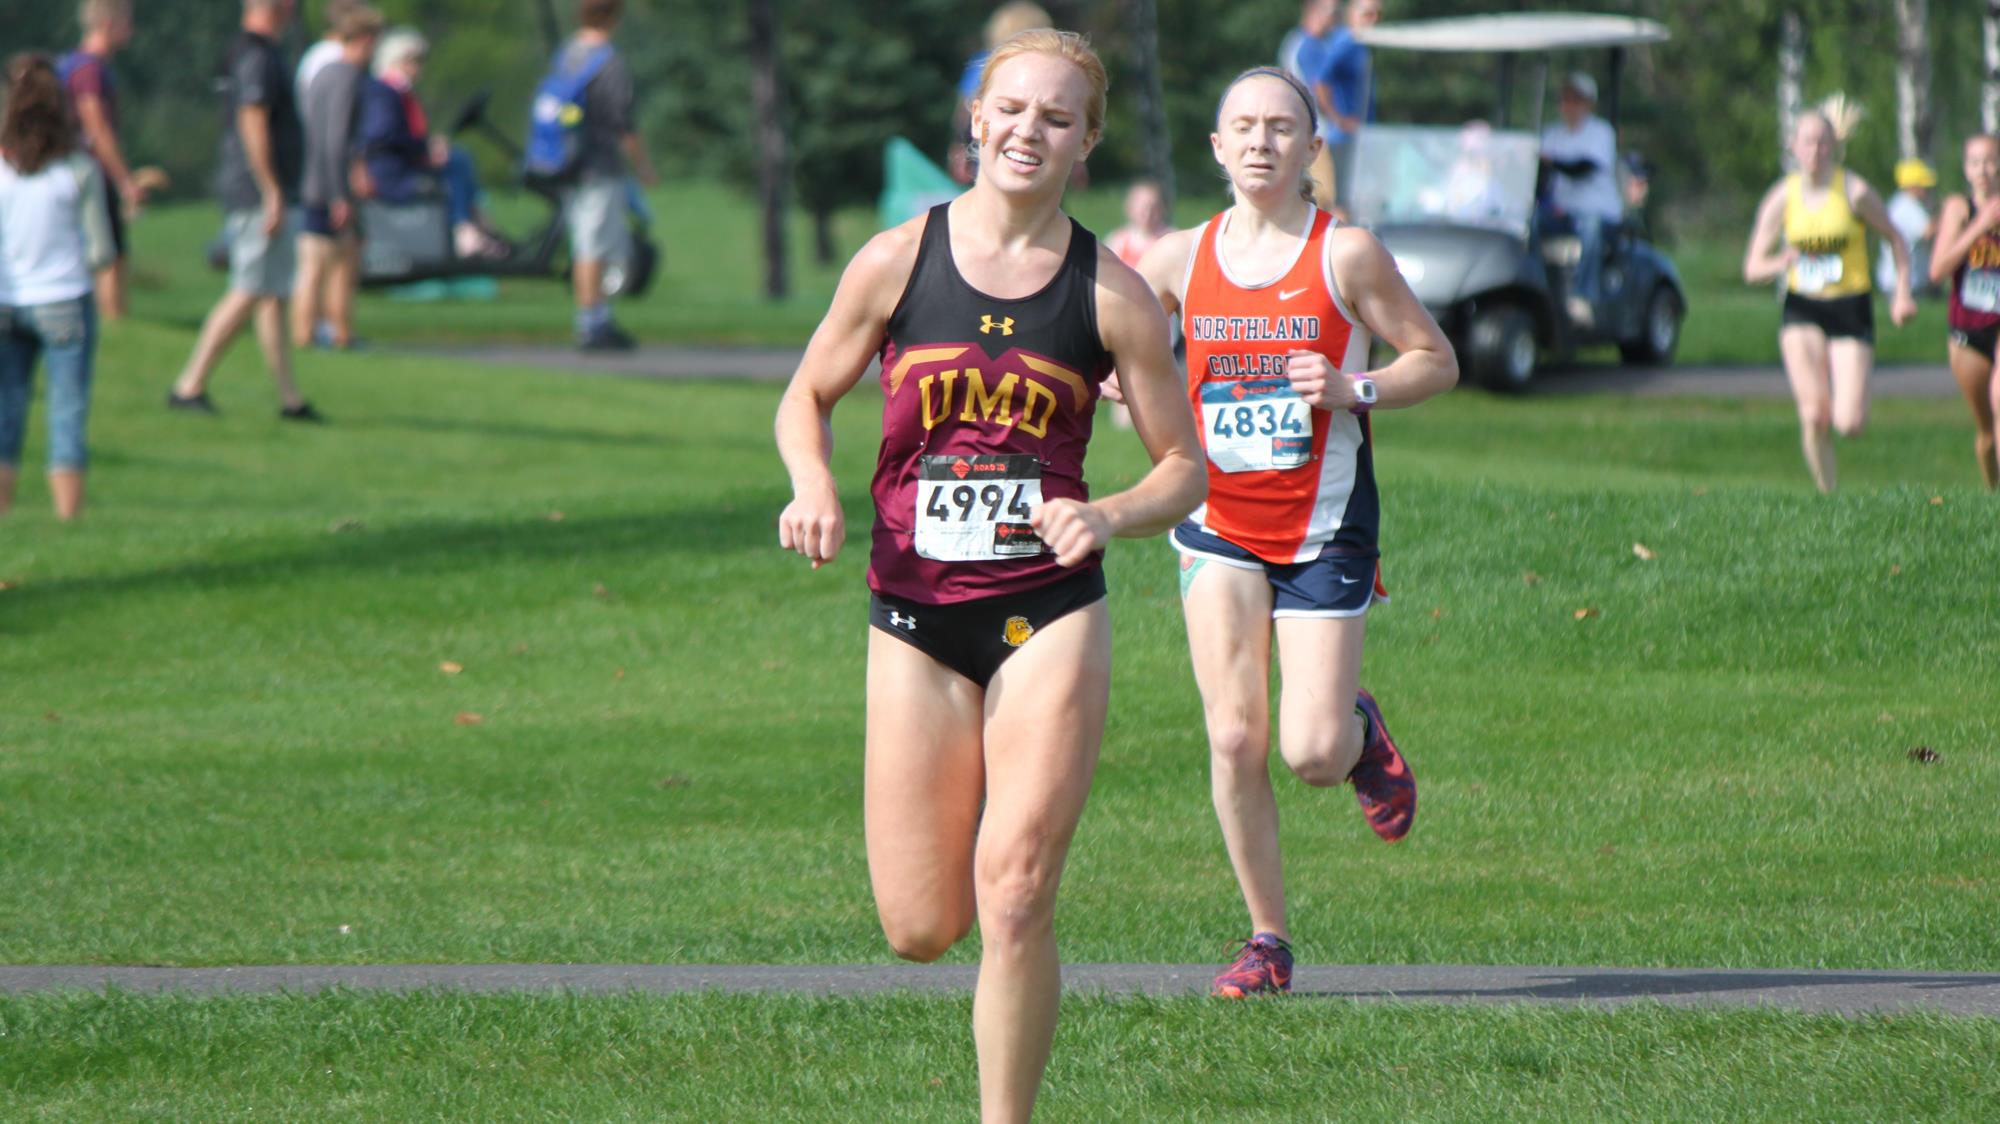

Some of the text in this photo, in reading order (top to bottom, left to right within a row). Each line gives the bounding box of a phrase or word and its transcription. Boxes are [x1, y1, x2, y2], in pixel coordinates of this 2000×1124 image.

[1193, 315, 1320, 341] NORTHLAND
[919, 368, 1057, 439] UMD
[1213, 403, 1303, 439] 4834
[973, 463, 996, 472] ROAD
[926, 484, 1031, 522] 4994
